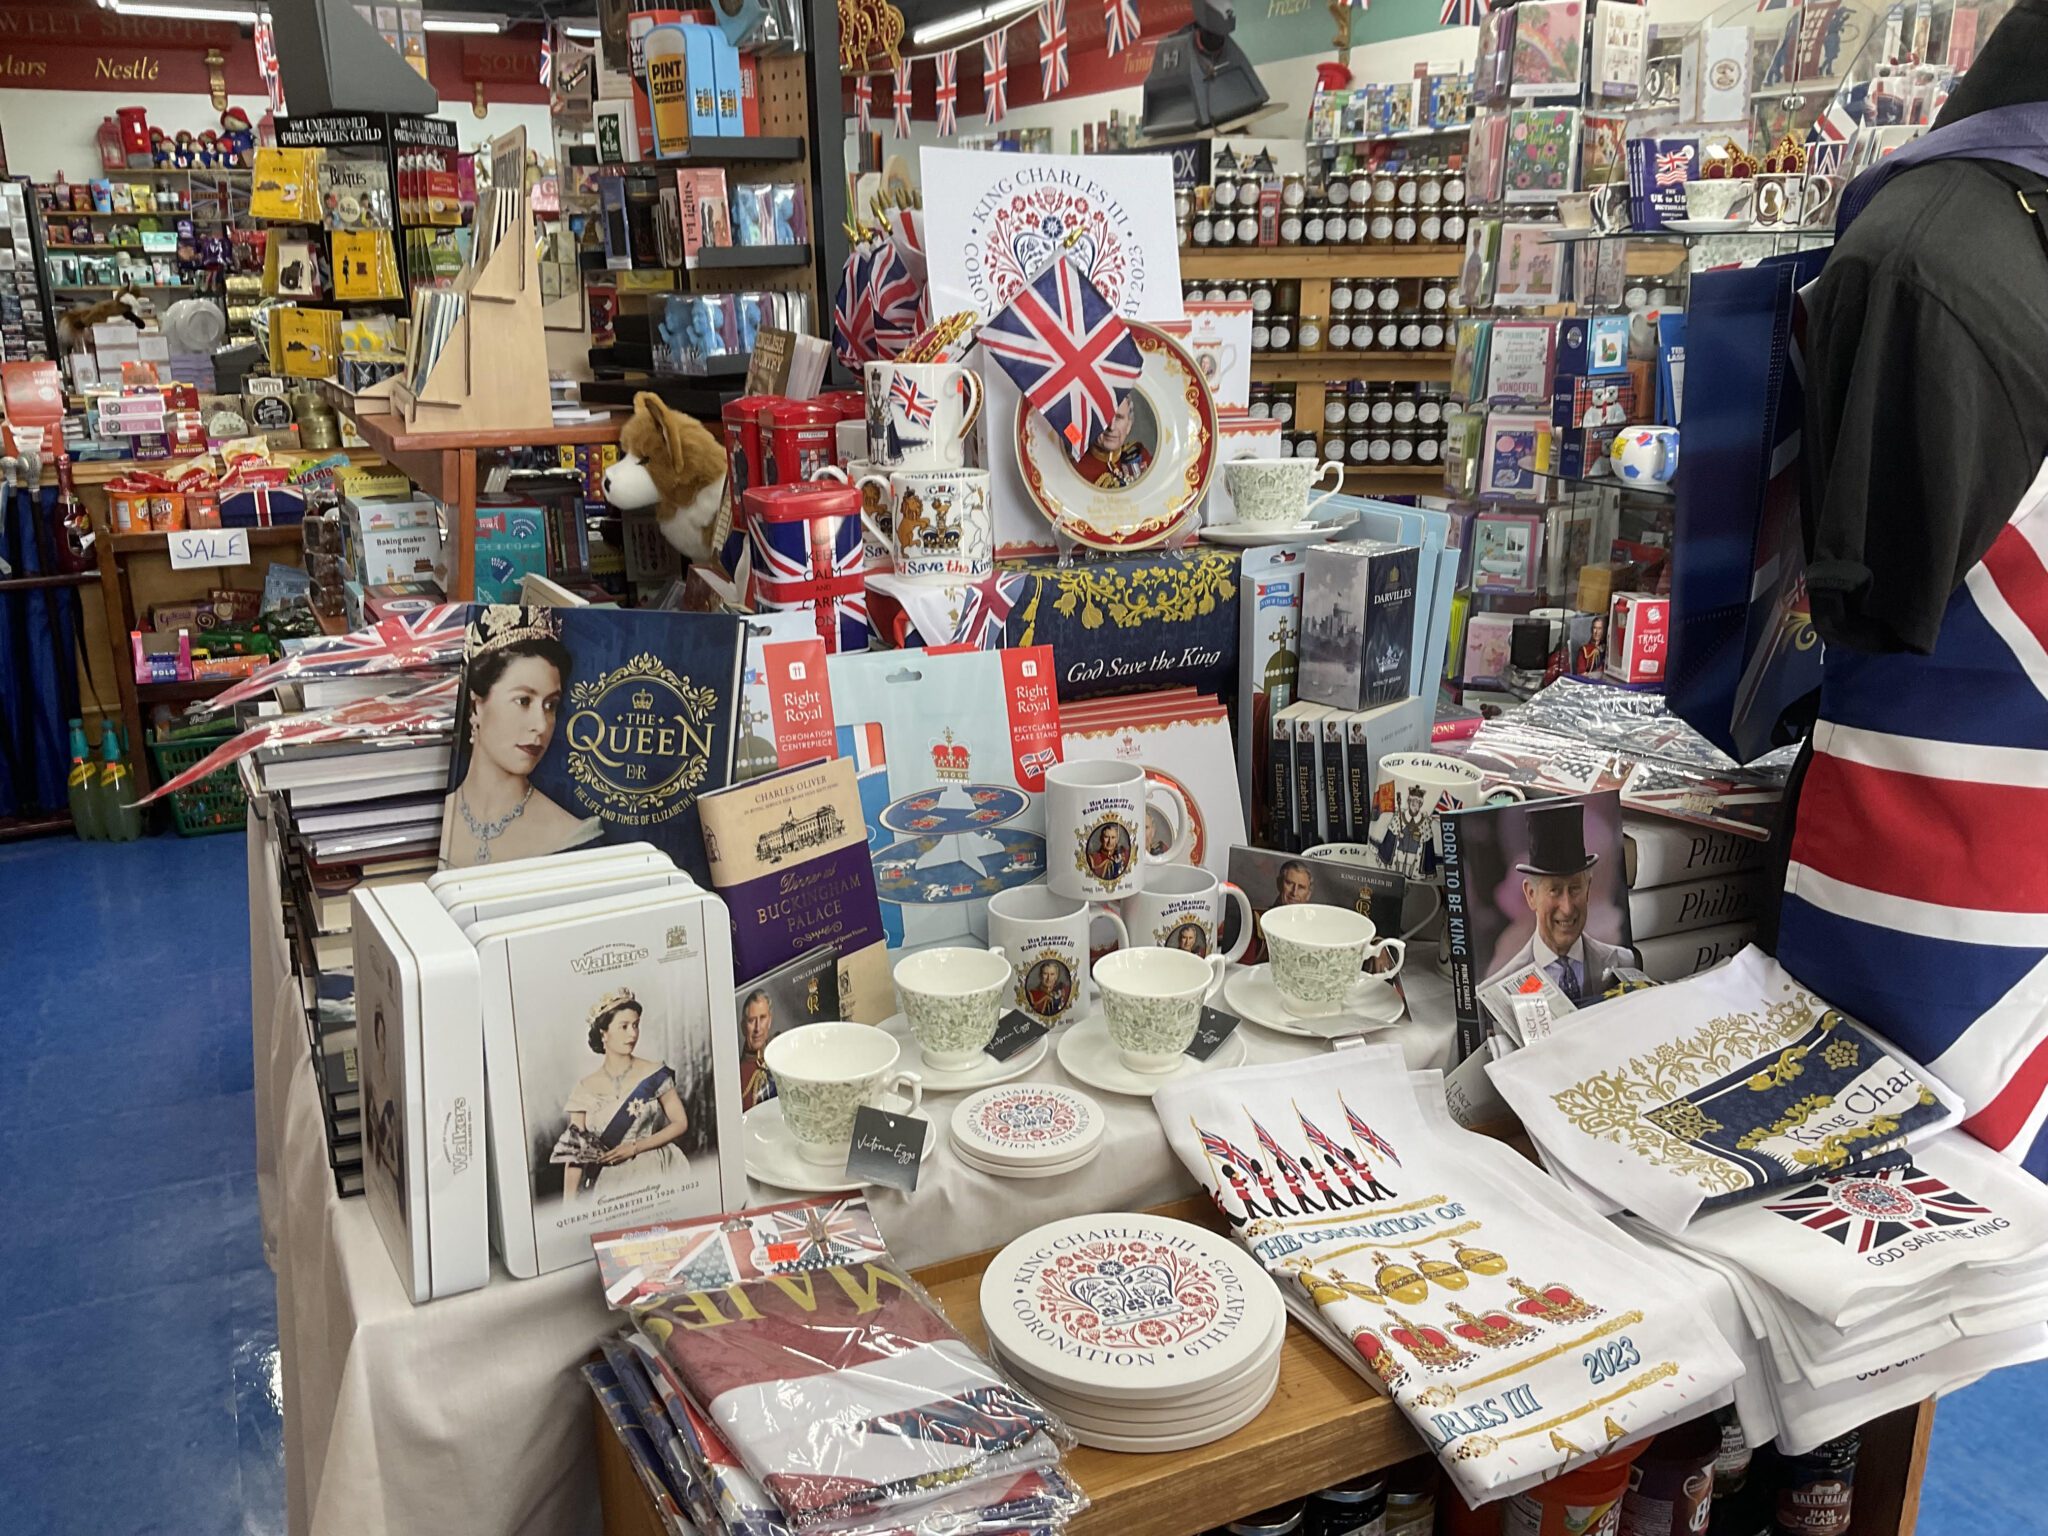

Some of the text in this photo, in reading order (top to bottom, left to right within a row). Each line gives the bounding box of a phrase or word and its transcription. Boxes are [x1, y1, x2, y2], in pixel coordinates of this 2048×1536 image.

[95, 56, 159, 80] Nestlé
[651, 60, 682, 80] PINT
[653, 80, 684, 96] SIZED
[306, 117, 368, 130] UNEMPLOYED
[350, 128, 382, 141] GUILD
[329, 166, 367, 188] BEATLES
[973, 167, 1129, 226] KING CHARLES III
[1650, 194, 1686, 204] UK to US
[1128, 245, 1146, 292] 2023
[1670, 346, 1685, 354] TED
[1496, 381, 1538, 393] WONDERFUL
[177, 533, 242, 561] SALE
[377, 535, 427, 548] Baking makes
[385, 545, 420, 557] me happy
[806, 547, 837, 563] KEEP
[803, 566, 842, 581] CALM
[908, 559, 970, 575] Save the
[815, 584, 832, 592] AND
[1373, 587, 1413, 605] DARVILLES
[802, 594, 846, 610] CARRY
[814, 615, 837, 628] ON
[1638, 633, 1665, 645] TRAVEL
[1643, 644, 1658, 653] CUP
[152, 669, 176, 677] POLO
[1067, 643, 1221, 684] God Save the King
[782, 689, 820, 710] Right
[1016, 684, 1049, 699] Right
[785, 704, 823, 726] Royal
[1018, 699, 1051, 716] Royal
[625, 712, 656, 726] THE
[1014, 723, 1058, 734] RECYCLABLE
[566, 709, 717, 768] QUEEN
[779, 729, 833, 743] CORONATION
[781, 738, 833, 752] CENTREPIECE
[1014, 730, 1058, 743] CAKE STAND
[1411, 758, 1463, 774] 6th MAY
[755, 775, 828, 804] CHARLES OLIVER
[1275, 763, 1285, 809] Elizabeth
[1299, 765, 1311, 823] Elizabeth II
[1326, 767, 1339, 824] Elizabeth II
[573, 785, 586, 802] THE
[584, 796, 601, 814] LIFE
[600, 808, 615, 822] AND
[617, 812, 640, 826] TIMES
[640, 814, 652, 826] OF
[651, 797, 693, 824] ELIZABETH
[1351, 767, 1363, 825] Elizabeth II
[1339, 847, 1360, 856] 6th
[1685, 834, 1757, 870] Philip
[1340, 873, 1358, 881] KING
[1358, 876, 1384, 886] CHARLES
[1441, 821, 1467, 956] BORN TO BE KING
[756, 873, 862, 925] BUCKINGHAM
[787, 899, 843, 933] PALACE
[570, 948, 649, 973] Walkers
[583, 945, 605, 957] PRODUCT
[587, 964, 622, 975] ESTABLISHED
[791, 972, 805, 985] KING
[805, 963, 827, 980] CHARLES
[1460, 963, 1472, 1011] PRINCE CHARLES
[1013, 1020, 1031, 1037] Eggs
[993, 1088, 1054, 1100] CHARLES
[452, 1096, 468, 1175] Walkers
[966, 1119, 1036, 1150] CORONATION
[1785, 1110, 1859, 1148] King
[857, 1133, 916, 1165] Victoria Eggs
[556, 1212, 589, 1228] QUEEN
[592, 1198, 644, 1218] ELIZABETH
[656, 1188, 676, 1199] 1926
[681, 1180, 700, 1192] 2022
[597, 1184, 662, 1206] Commemorating
[605, 1203, 655, 1221] LIMITED EDITION
[1253, 1201, 1468, 1263] THE CORONATION OF
[1866, 1216, 2011, 1266] GOD SAVE THE KING
[1014, 1228, 1197, 1285] KING CHARLES III
[1012, 1258, 1245, 1367] CORONATION 6TH MAY 2023
[1582, 1336, 1643, 1385] 2023
[1502, 1384, 1544, 1420] III
[1804, 1515, 1839, 1524] GLAZE
[1809, 1509, 1835, 1518] HAM
